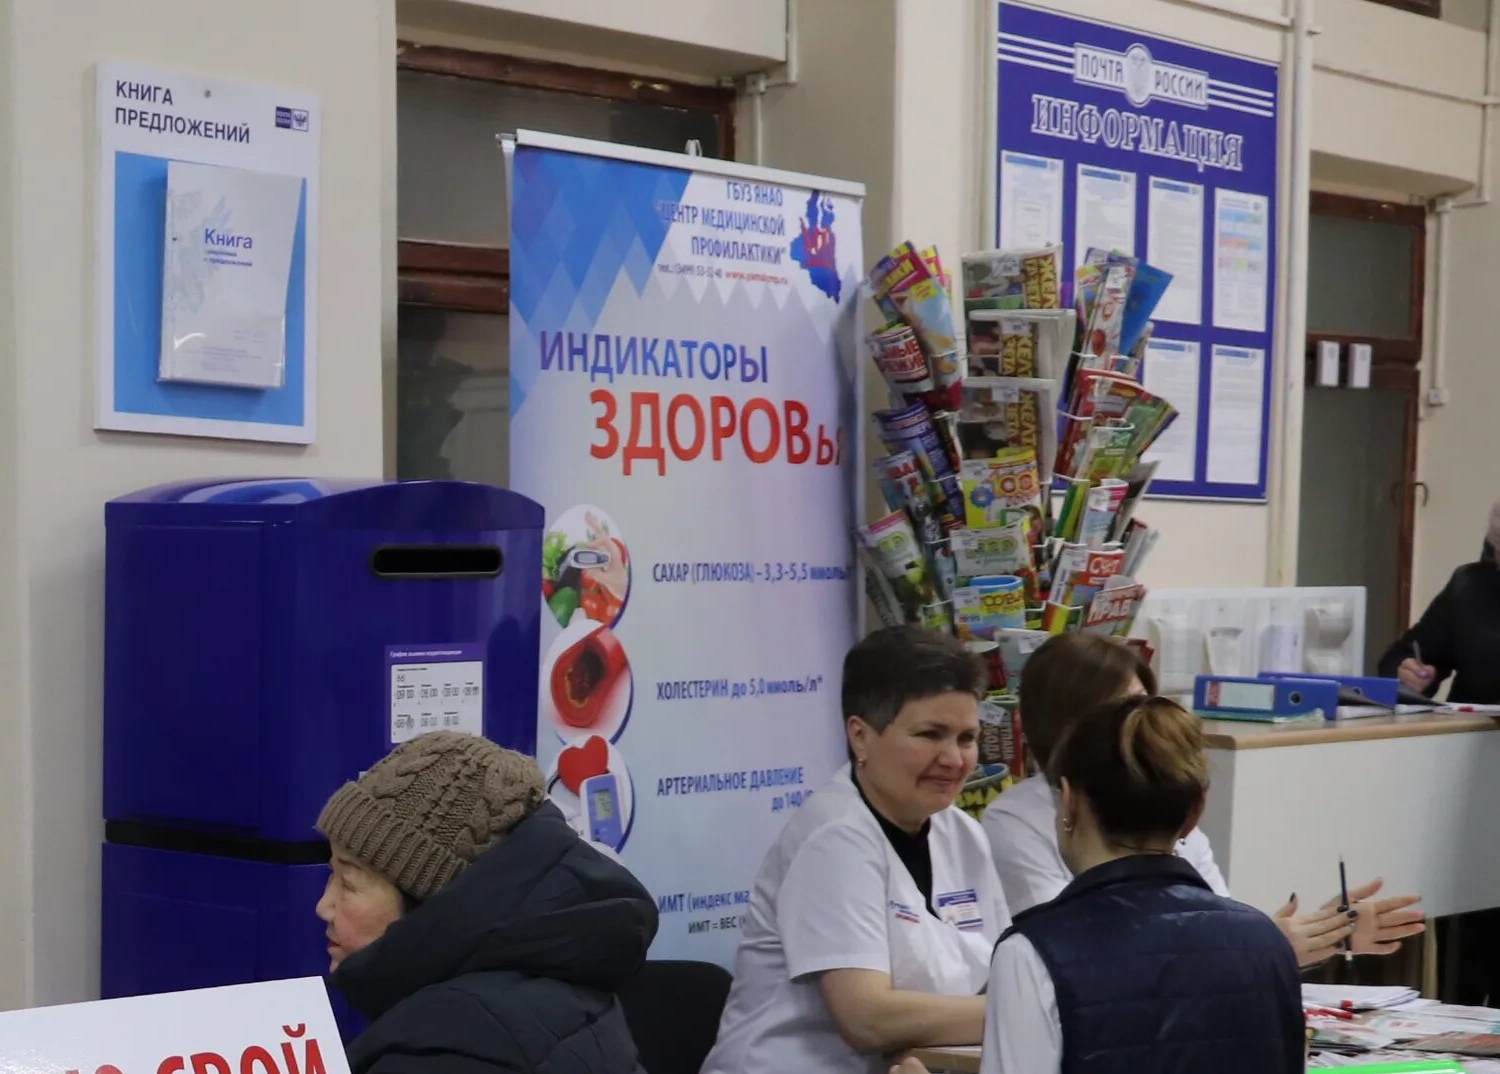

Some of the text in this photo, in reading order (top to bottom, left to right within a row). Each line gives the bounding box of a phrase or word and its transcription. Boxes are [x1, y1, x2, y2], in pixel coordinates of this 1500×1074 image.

[1080, 54, 1203, 99] ПОЧТА РОССИИ
[115, 79, 174, 106] КНИГА
[115, 106, 251, 145] ПРЕДЛОЖЕНИЙ
[1030, 93, 1244, 173] ИНФОРМАЦИЯ
[726, 180, 784, 207] ГБУЗ ЯНАО
[701, 206, 787, 237] МЕДИЦИНСКОЙ
[203, 228, 254, 250] Книга
[539, 329, 769, 385] ИНДИКАТОРЫ
[652, 562, 690, 584] САХАР
[691, 562, 754, 584] (ГЛЮКОЗА)
[656, 678, 729, 701] ХОЛЕСТЕРИН
[731, 683, 747, 699] до
[656, 765, 805, 797] АРТЕРИАЛЬНОЕ ДАВЛЕНИЕ
[771, 794, 785, 813] до
[658, 893, 685, 913] ИМТ
[687, 890, 732, 913] (индекс
[688, 920, 711, 934] ИМТ
[719, 915, 737, 930] ВЕС
